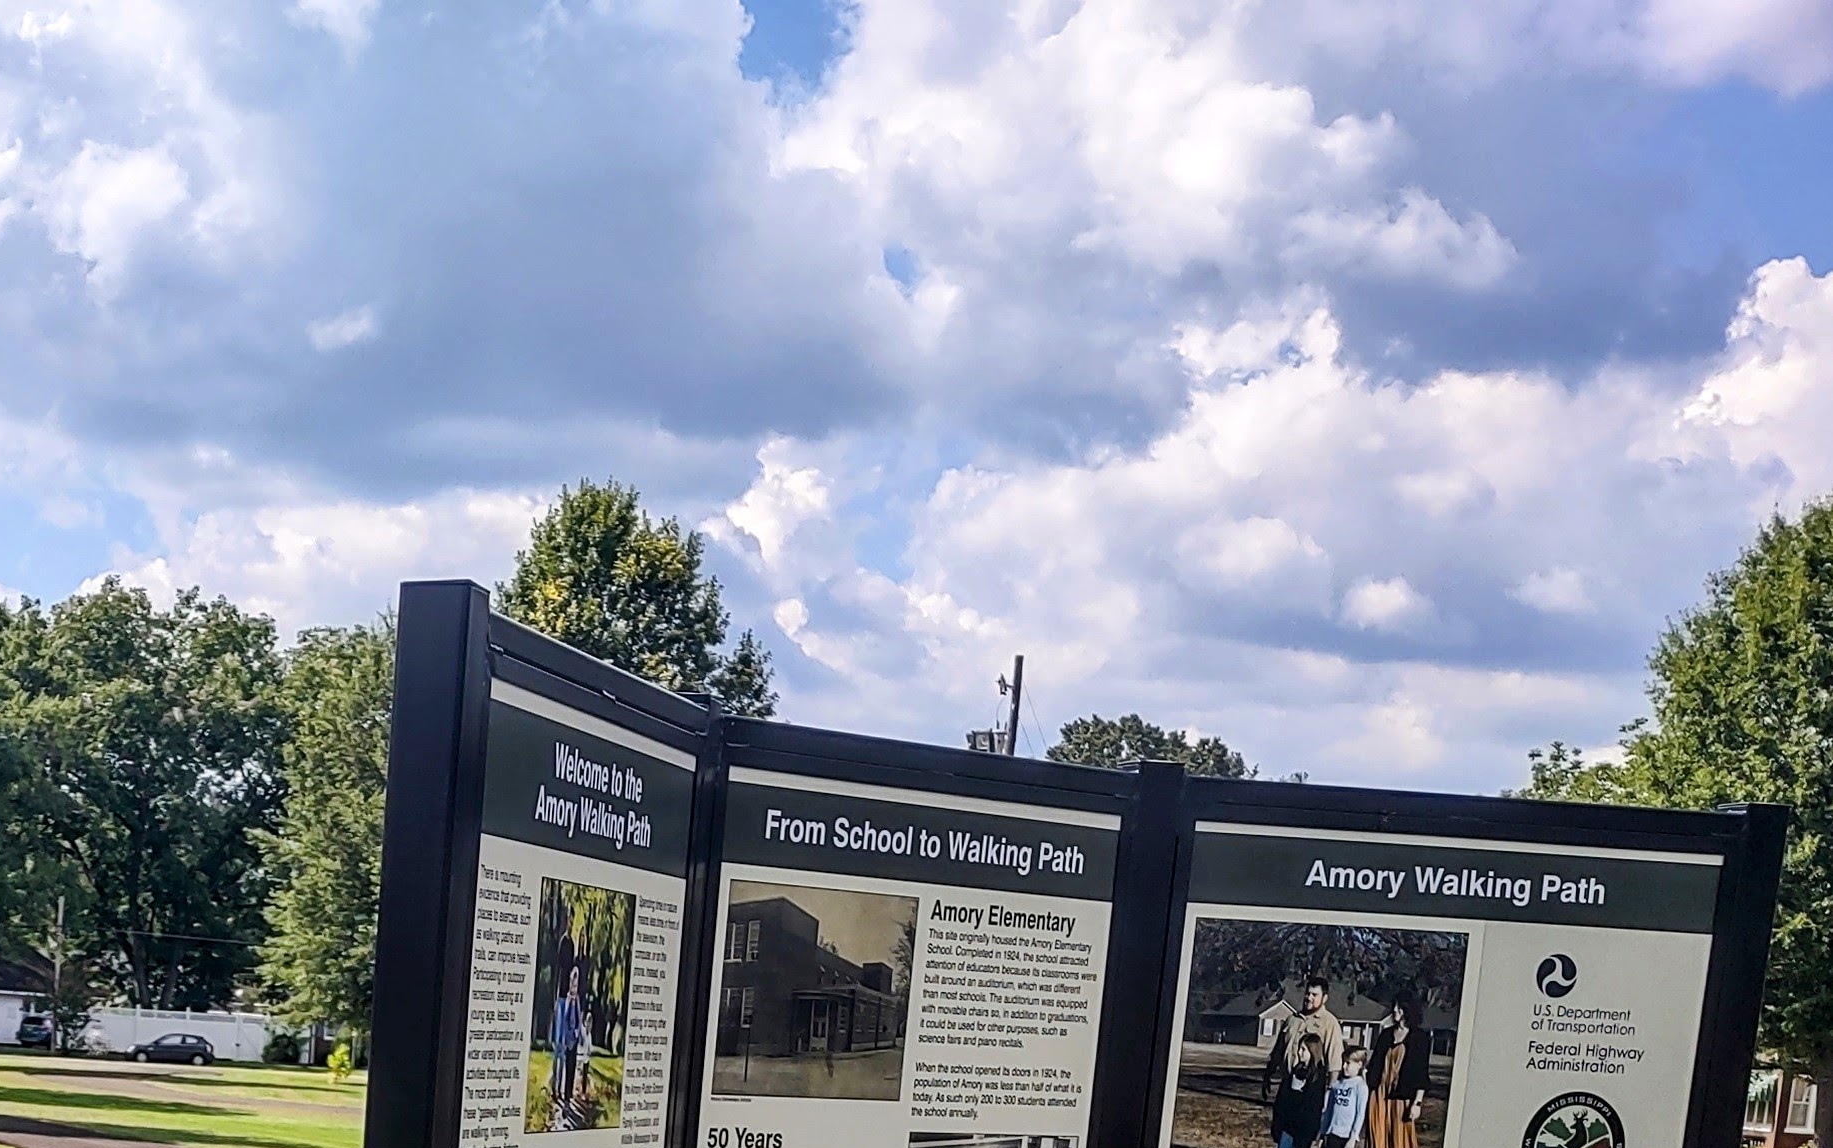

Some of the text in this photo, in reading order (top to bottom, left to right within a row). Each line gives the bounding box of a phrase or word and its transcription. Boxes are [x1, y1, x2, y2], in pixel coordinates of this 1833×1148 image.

[556, 742, 642, 802] Welcome to the
[535, 785, 650, 849] Amory Walking Path
[765, 809, 1083, 875] From School to Walking Path
[1305, 860, 1605, 906] Amory Walking Path
[931, 900, 1075, 938] Amory Elementary
[1531, 1014, 1635, 1035] of Transportation
[1534, 1004, 1630, 1020] U.S. Department
[1526, 1057, 1624, 1074] Administration
[1529, 1041, 1644, 1067] Federal Highway
[1547, 1096, 1611, 1117] MISSISSIPPI
[707, 1128, 782, 1148] 50 Years
